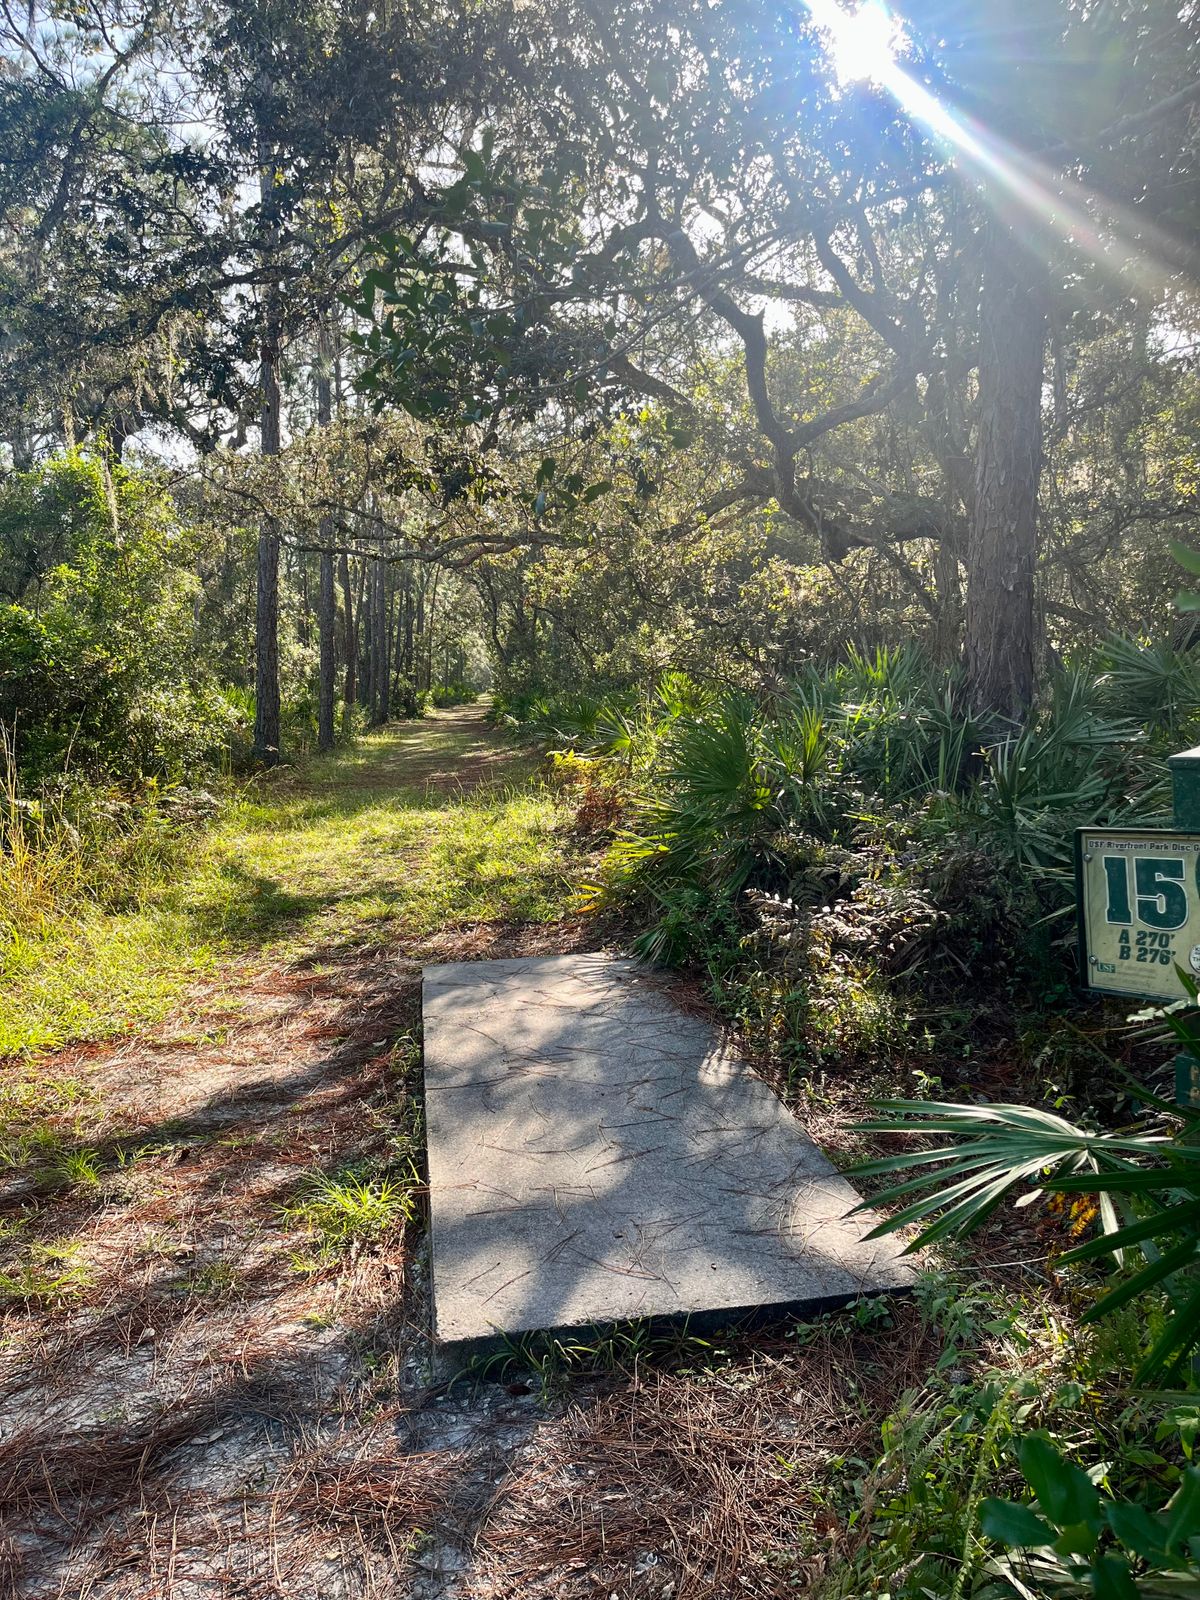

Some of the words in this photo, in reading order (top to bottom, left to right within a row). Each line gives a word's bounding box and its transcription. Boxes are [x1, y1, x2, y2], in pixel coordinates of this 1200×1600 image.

[1107, 841, 1147, 850] Riverfront
[1149, 842, 1169, 851] Park
[1172, 843, 1191, 851] Disc
[1102, 855, 1189, 930] 15
[1118, 929, 1130, 944] A
[1135, 930, 1176, 949] 270'
[1119, 945, 1131, 960] B
[1136, 946, 1177, 965] 276'
